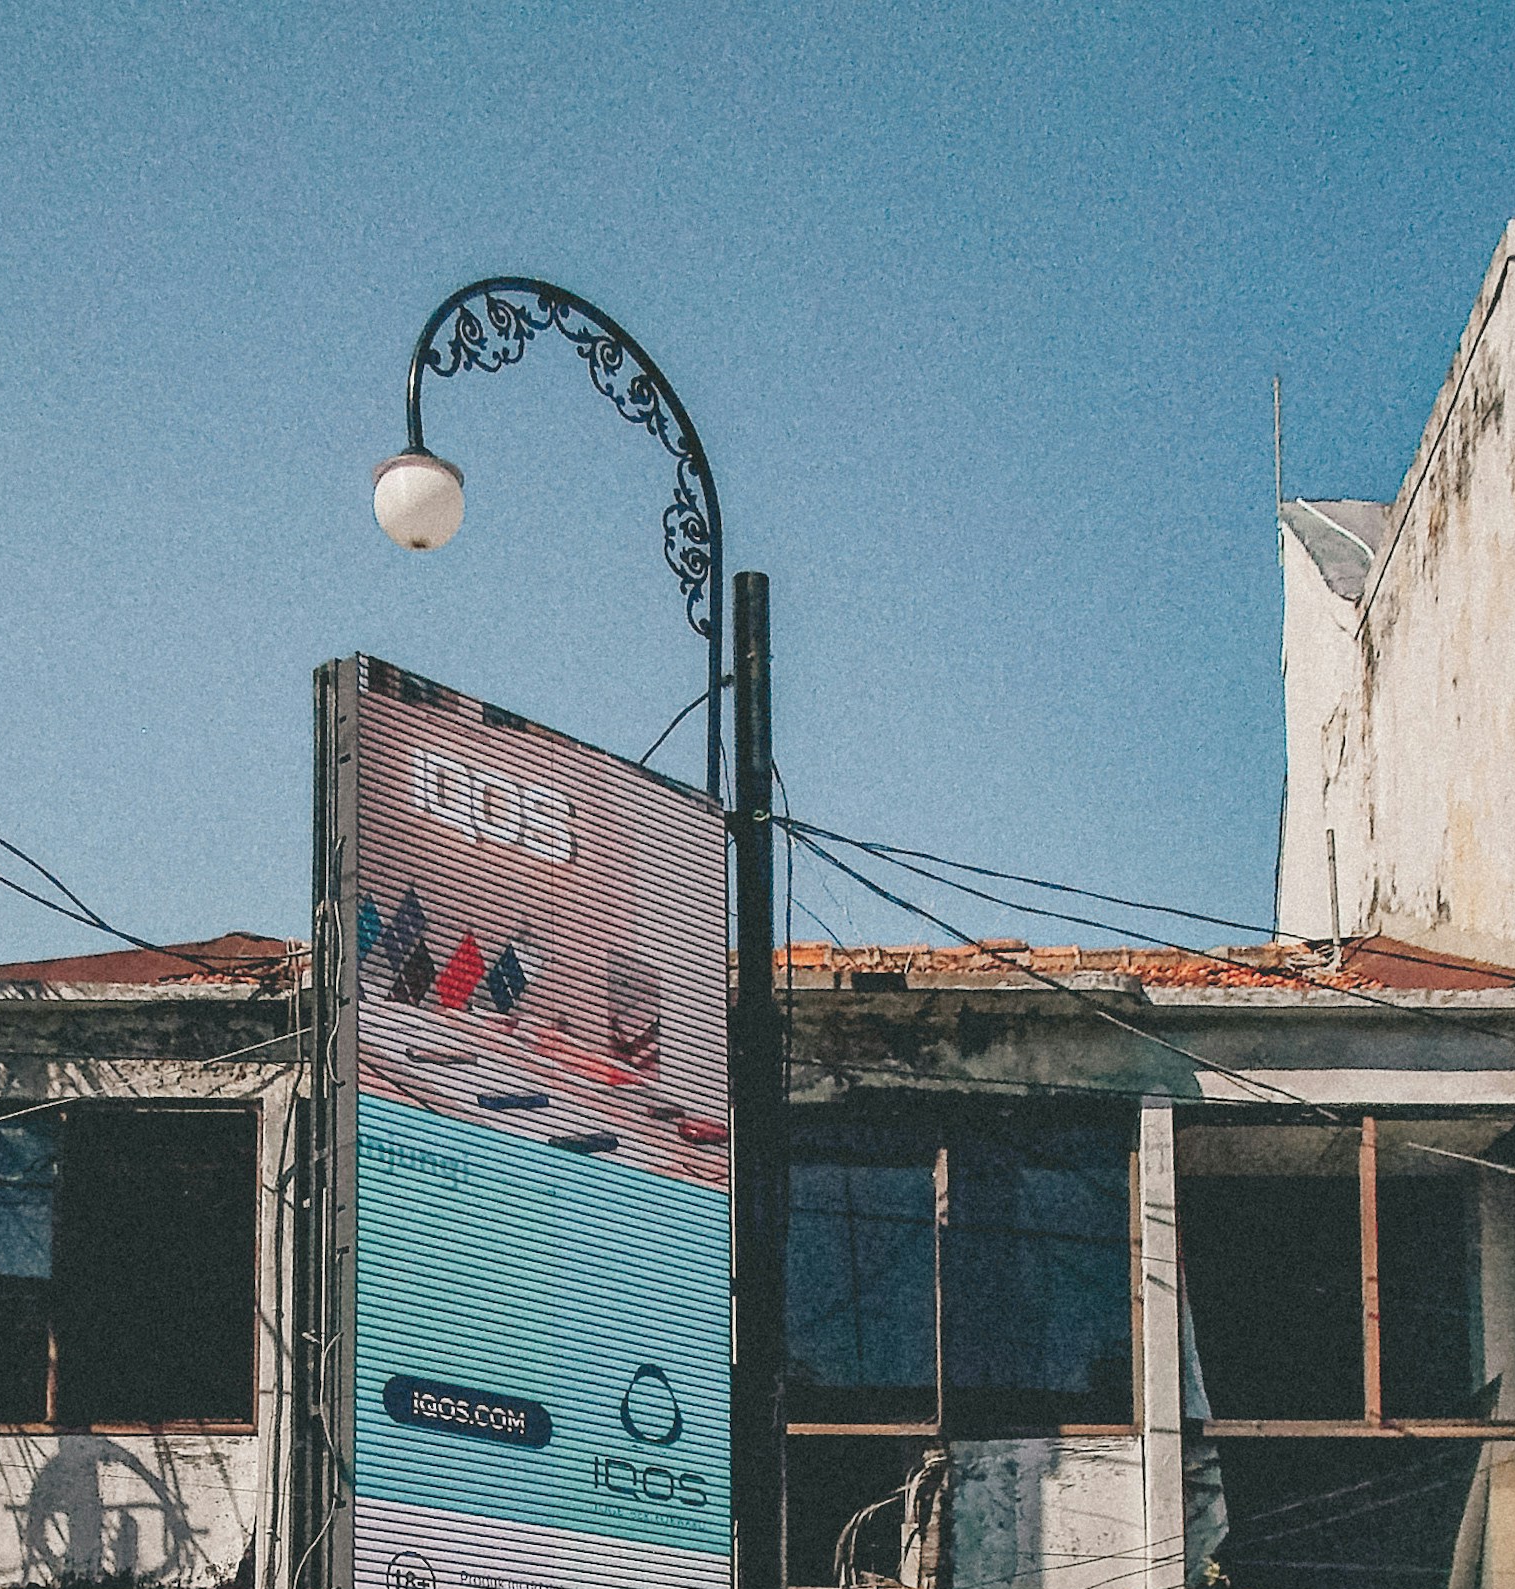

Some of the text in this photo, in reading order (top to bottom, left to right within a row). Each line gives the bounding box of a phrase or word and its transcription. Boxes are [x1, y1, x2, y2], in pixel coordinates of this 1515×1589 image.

[413, 748, 574, 864] IQOS
[413, 1391, 526, 1435] IQOS.COM
[594, 1456, 707, 1507] IQOS
